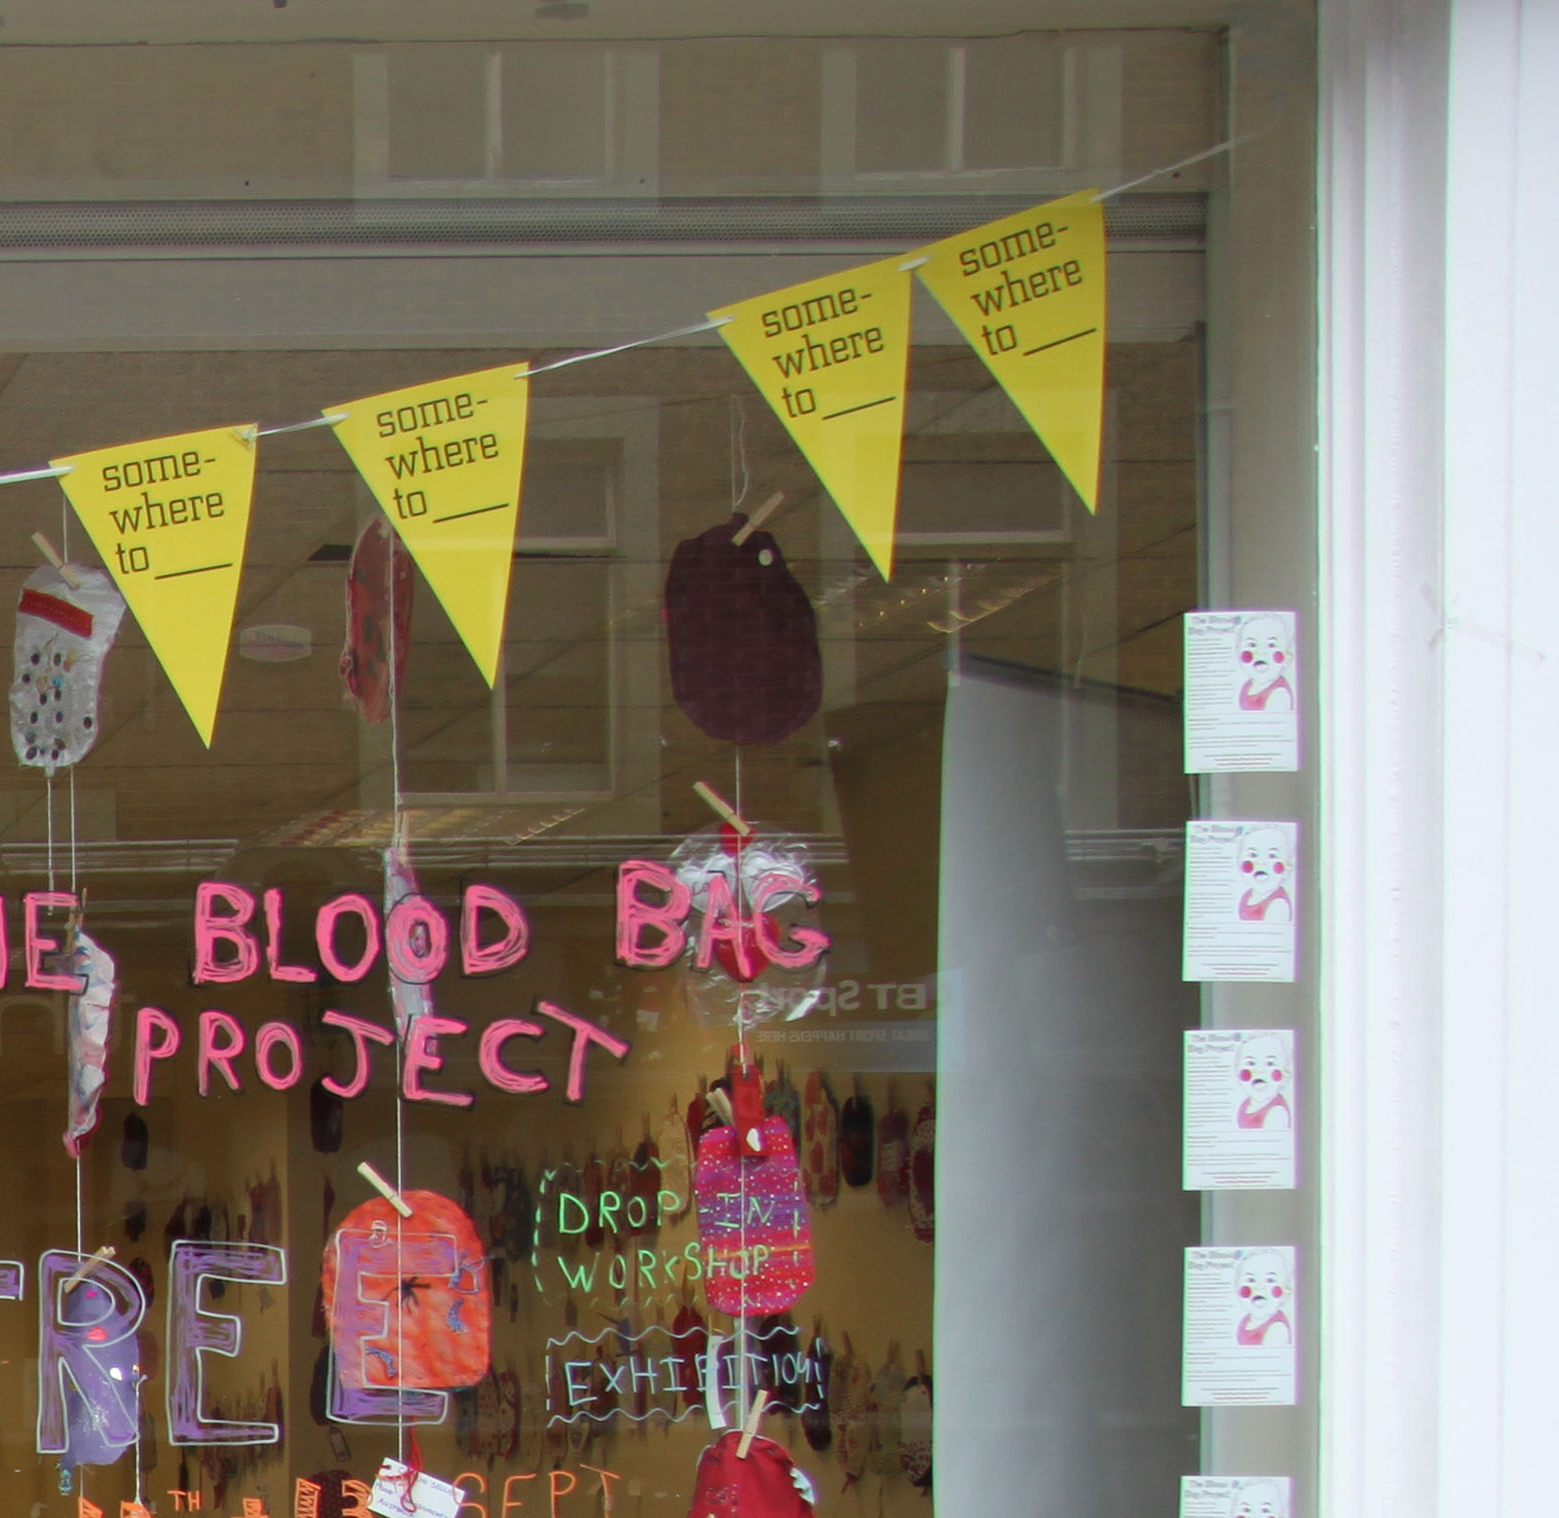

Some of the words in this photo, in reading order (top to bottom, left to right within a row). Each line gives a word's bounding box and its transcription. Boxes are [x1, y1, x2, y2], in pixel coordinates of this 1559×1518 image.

[959, 221, 1069, 278] some-
[762, 285, 872, 339] some-
[971, 256, 1082, 318] where
[772, 323, 885, 380] where
[377, 390, 488, 440] some-
[102, 447, 217, 493] some-
[385, 428, 500, 483] where
[109, 485, 225, 537] where
[191, 880, 531, 988] BLOOD
[615, 857, 832, 984] BAG
[133, 998, 632, 1111] PROJECT
[556, 1241, 773, 1294] WORKSHOP
